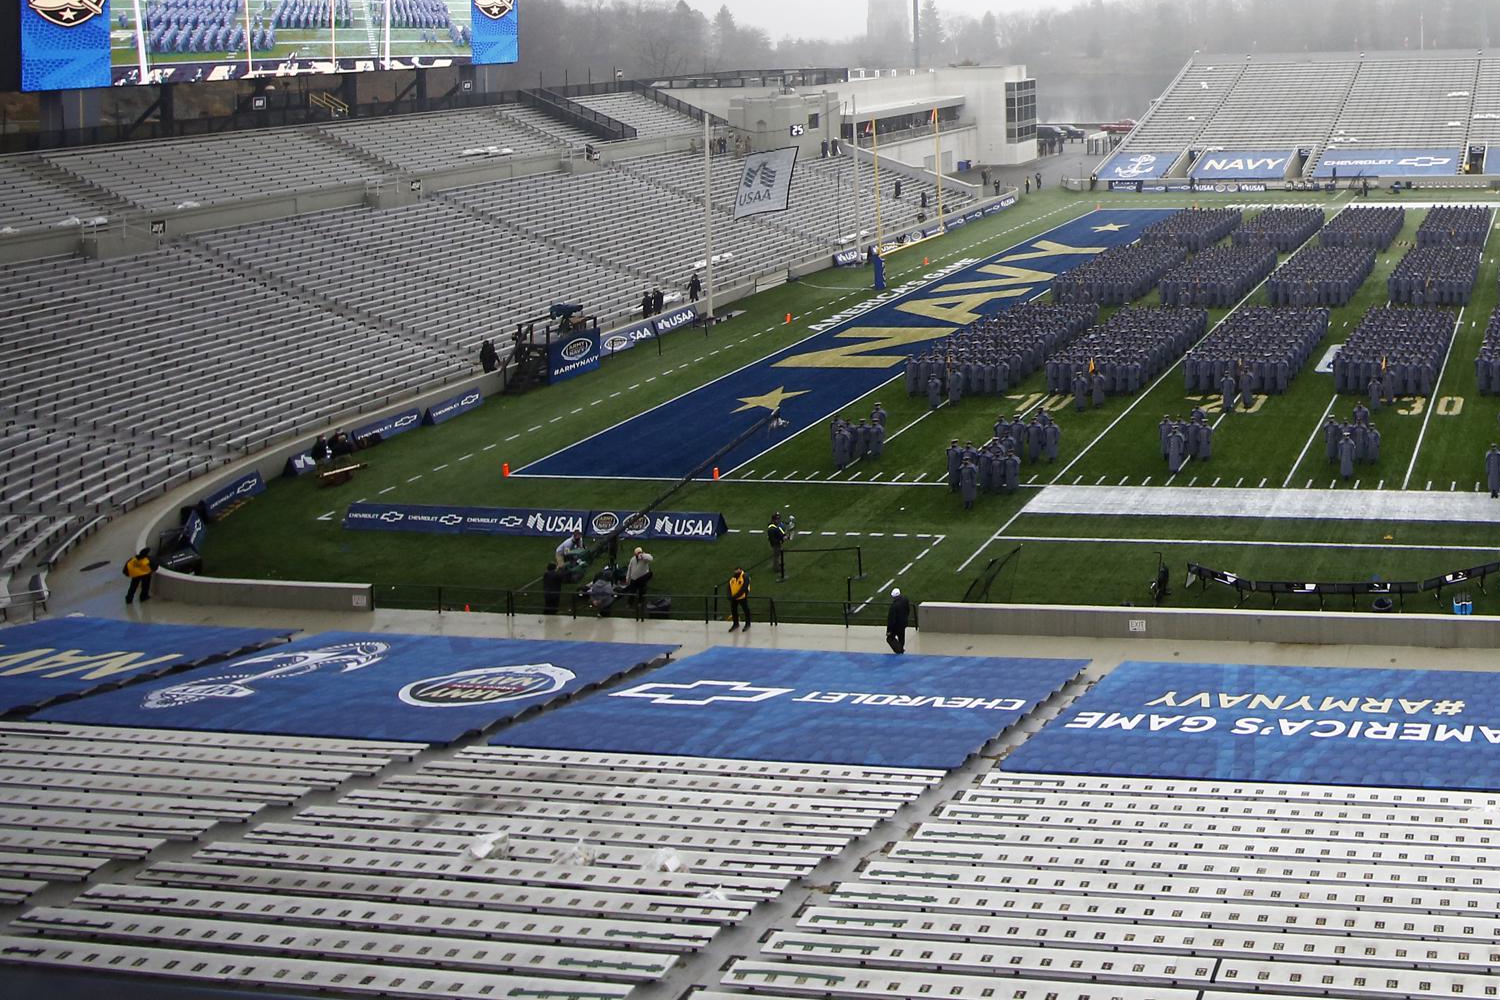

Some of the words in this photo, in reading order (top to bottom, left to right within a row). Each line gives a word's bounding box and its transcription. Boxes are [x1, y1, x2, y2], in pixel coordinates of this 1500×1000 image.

[792, 124, 804, 136] 25
[1203, 158, 1285, 170] NAVY
[739, 189, 771, 206] USAA
[923, 257, 981, 281] GAME
[770, 239, 1106, 368] NAVY
[670, 310, 694, 326] USAA
[629, 328, 651, 342] SAA
[568, 341, 585, 351] ARMY
[554, 354, 599, 376] #ARMYNAVY
[1397, 396, 1464, 416] 30
[545, 516, 583, 533] USAA
[674, 519, 713, 536] USAA
[0, 645, 183, 681] NAV
[419, 689, 512, 700] ARMY
[793, 690, 1027, 711] CHEVROLET
[1144, 691, 1466, 716] #ARMYNAVY
[1064, 711, 1217, 733] GAME
